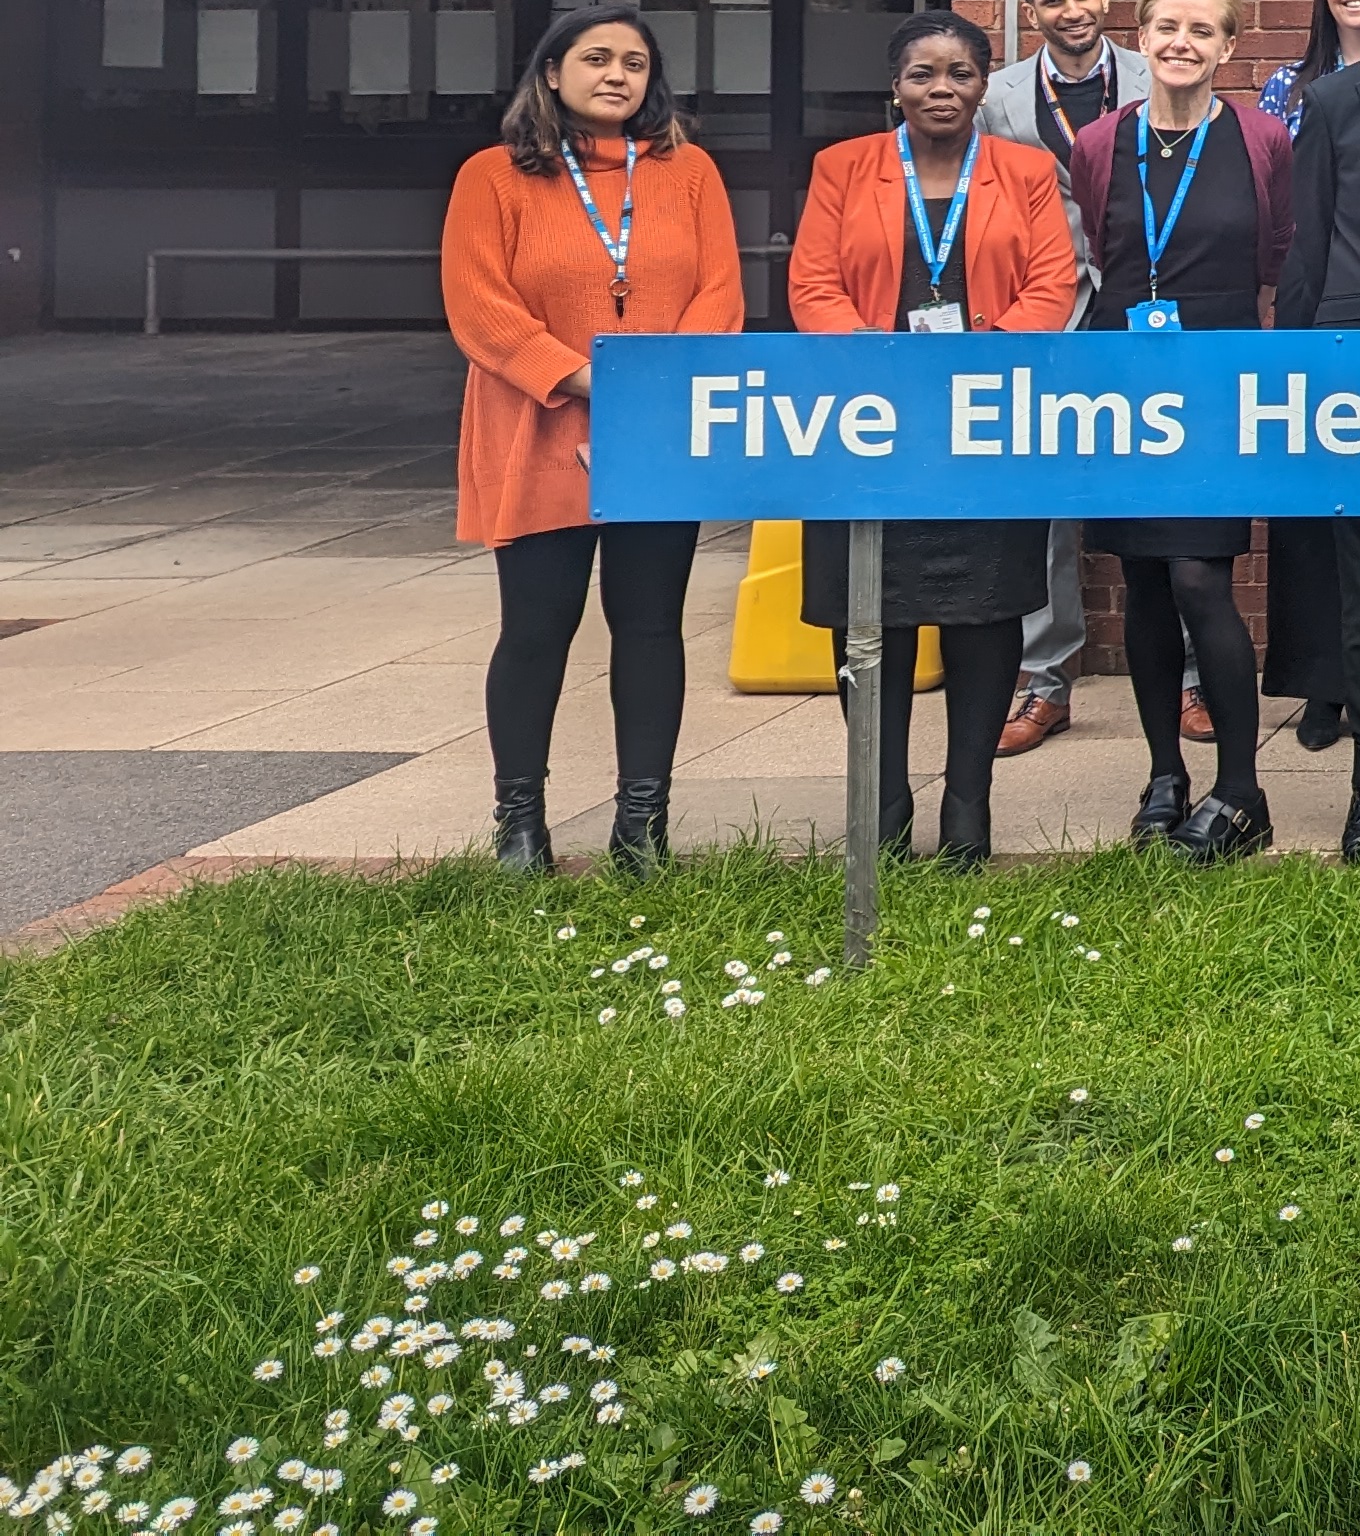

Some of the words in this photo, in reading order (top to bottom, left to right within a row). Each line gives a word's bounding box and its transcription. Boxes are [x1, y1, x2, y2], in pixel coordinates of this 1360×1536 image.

[937, 243, 951, 263] NHS
[690, 370, 897, 457] Five
[951, 367, 1185, 456] Elms
